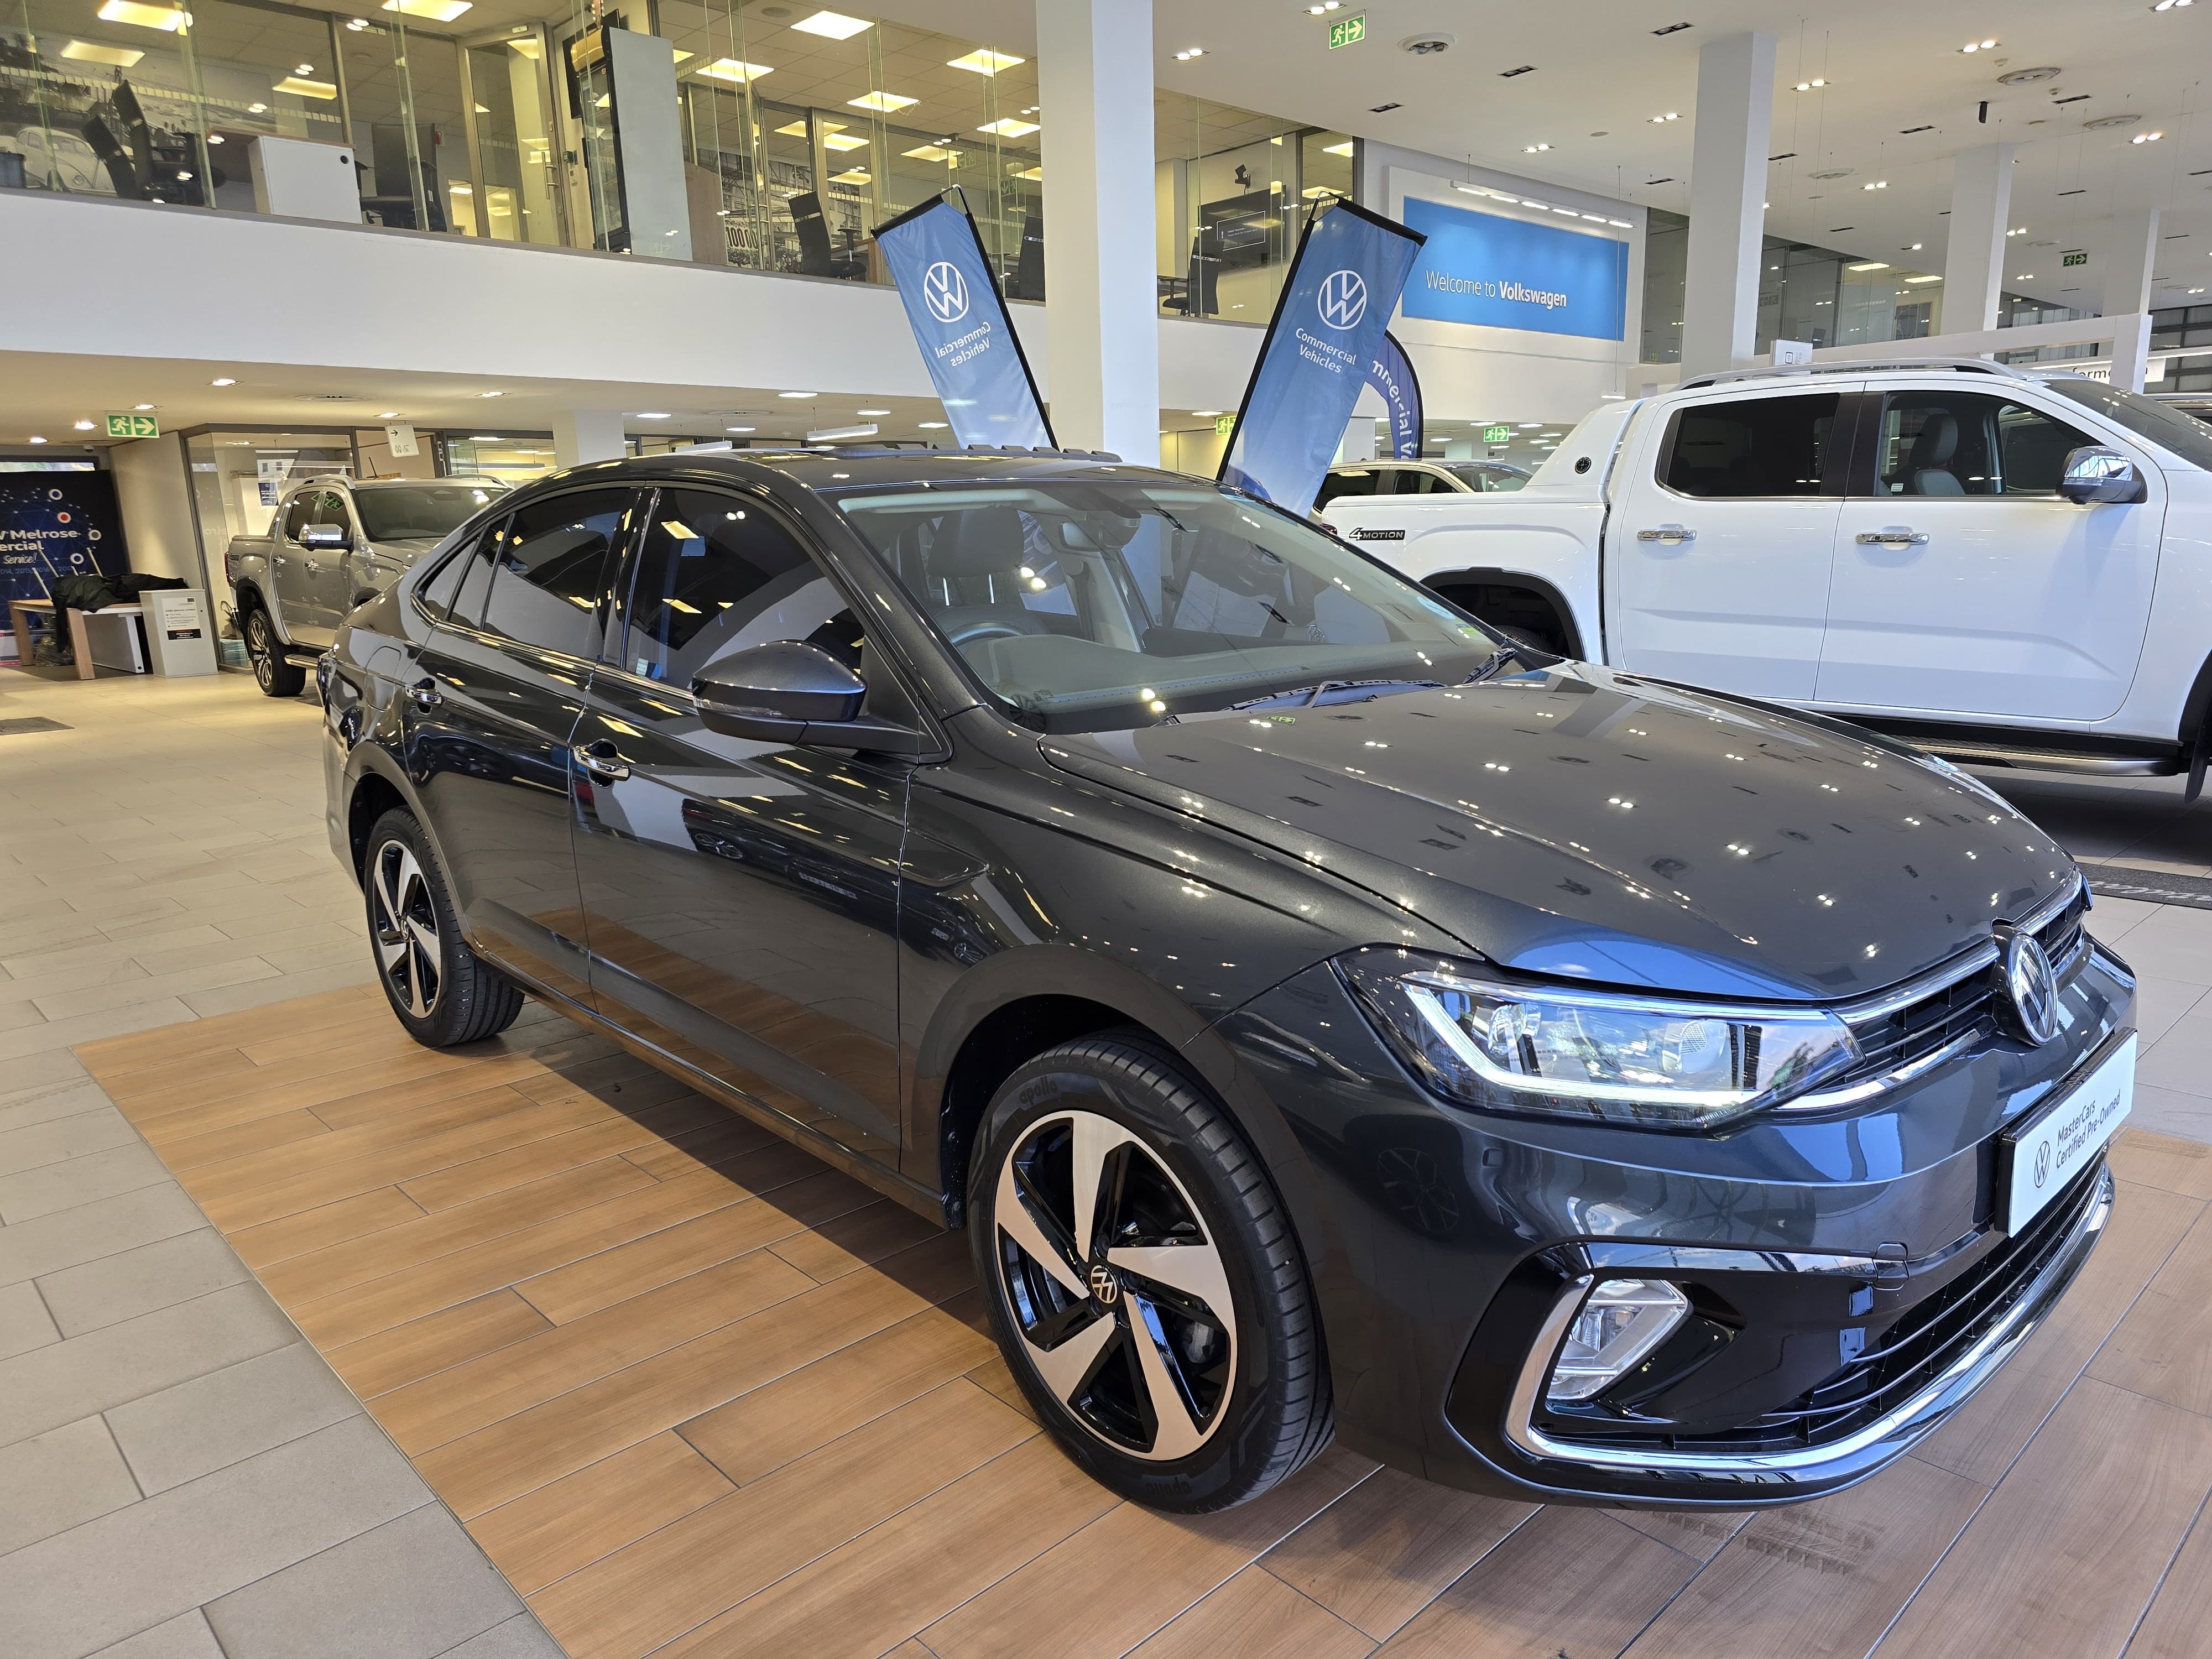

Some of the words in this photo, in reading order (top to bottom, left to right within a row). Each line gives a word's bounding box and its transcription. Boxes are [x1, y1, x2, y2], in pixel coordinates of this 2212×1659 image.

[1318, 270, 1367, 330] VW
[1426, 269, 1481, 296] Welcome
[1485, 280, 1496, 298] to
[1499, 280, 1567, 310] Volkswagen
[1296, 328, 1357, 365] Commercial
[1300, 344, 1342, 373] Vehicles
[10, 529, 78, 539] Melrose
[1349, 528, 1403, 540] 4MOTION
[3, 552, 37, 564] Service!
[1019, 1076, 1057, 1105] apollo
[2057, 1126, 2086, 1168] Certified
[2088, 1088, 2121, 1139] Pre-Owned
[2058, 1100, 2095, 1147] MasterCars
[2034, 1140, 2050, 1188] VW
